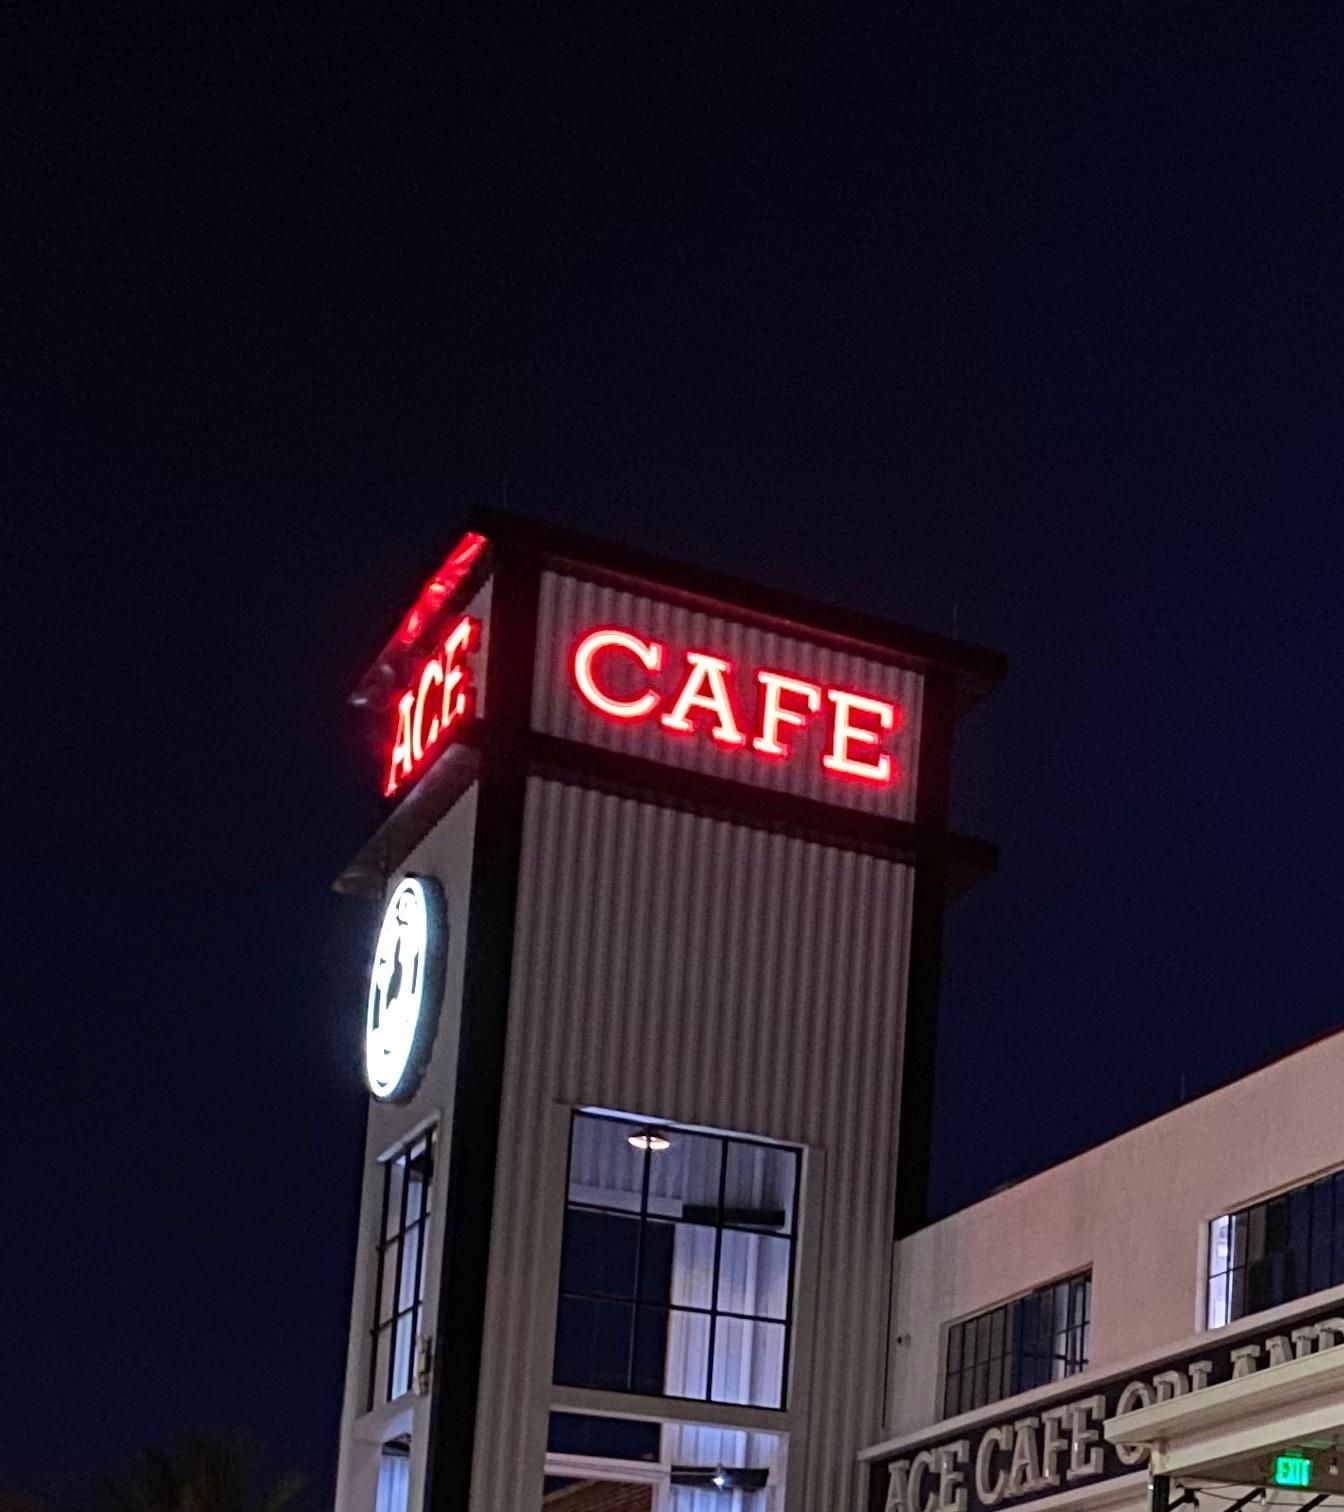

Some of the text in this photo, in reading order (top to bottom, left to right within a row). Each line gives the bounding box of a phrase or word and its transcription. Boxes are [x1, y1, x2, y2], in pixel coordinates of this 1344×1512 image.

[384, 616, 898, 797] ACE CAFE
[976, 1394, 1106, 1505] CAFE
